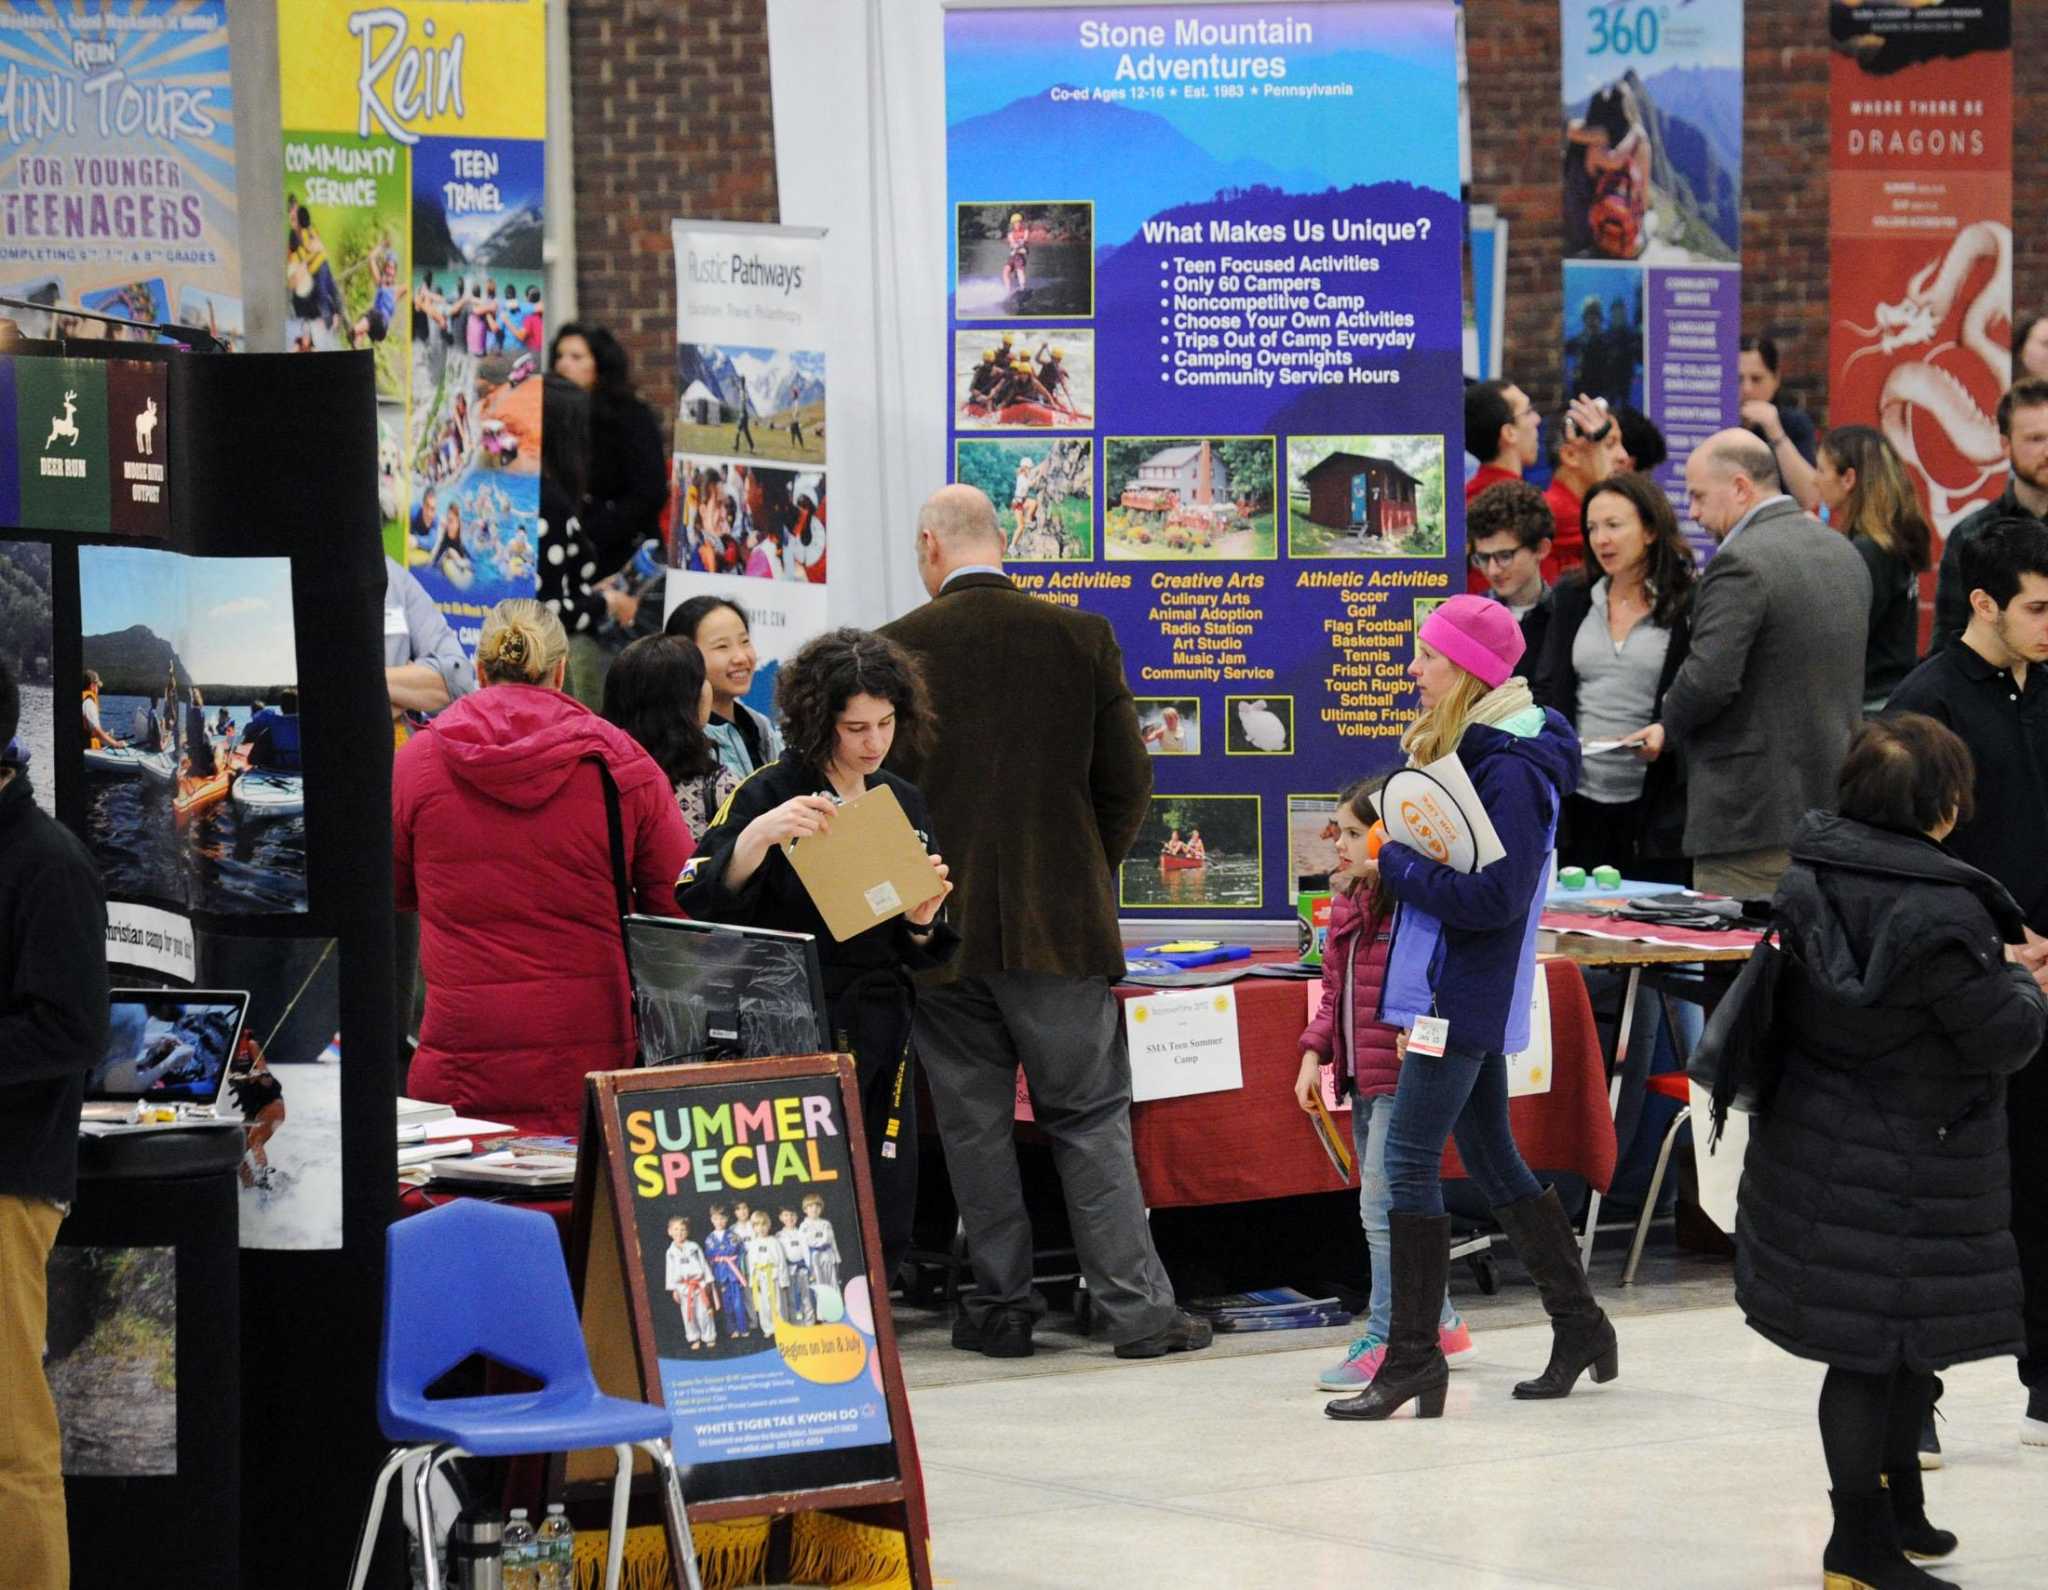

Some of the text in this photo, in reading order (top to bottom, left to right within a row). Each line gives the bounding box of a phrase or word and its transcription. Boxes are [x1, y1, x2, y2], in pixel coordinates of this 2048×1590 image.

[1079, 17, 1313, 48] Stone Mountain
[1114, 53, 1287, 81] Adventures
[349, 8, 465, 145] Rein
[1051, 83, 1353, 102] Co-ed Ages 12-16 Est. 1983 Pennsylvania
[1850, 100, 1984, 117] WHERE THERE BE
[1848, 129, 1984, 156] DRAGONS
[285, 143, 396, 176] COMMUNITY
[450, 149, 499, 179] TEEN
[19, 156, 180, 189] FOR YOUNGER
[305, 176, 377, 208] SERVICE
[443, 181, 504, 214] TRAVEL
[3, 193, 202, 242] TEENAGERS
[1142, 218, 1431, 246] What Makes Us Unique?
[0, 249, 76, 263] OMPLETING
[1174, 255, 1379, 273] Teen Focused Activities
[731, 254, 803, 297] Pathways
[1174, 275, 1321, 295] Only 60 Campers
[1174, 293, 1365, 315] Noncompetitive Camp
[1174, 310, 1414, 329] Choose Your Own Activities
[1174, 329, 1416, 350] Trips Out of Camp Everyday
[1174, 349, 1353, 369] Camping Overnights
[1174, 367, 1400, 388] Community Service Hours
[40, 457, 87, 478] DEER RUN
[1010, 571, 1132, 589] ture Activities
[1151, 572, 1265, 589] Creative Arts
[1296, 570, 1449, 587] Athletic Activities
[1028, 590, 1079, 607] limbing
[1161, 593, 1251, 607] Culinary Arts
[1340, 590, 1390, 603] Soccer
[1148, 607, 1263, 623] Animal Adoption
[1347, 605, 1377, 618] Golf
[1161, 622, 1253, 635] Radio Station
[1324, 619, 1412, 635] Flag Football
[1173, 637, 1242, 650] Art Studio
[1332, 634, 1404, 647] Basketball
[1173, 652, 1246, 664] Music Jam
[1343, 649, 1391, 662] Tennis
[1142, 667, 1275, 682] Community Service
[1332, 664, 1405, 677] Frisbi Golf
[1324, 679, 1416, 695] Touch Rugby
[1340, 693, 1393, 707] Softball
[1321, 708, 1378, 721] Ultimate
[1337, 723, 1404, 738] Volleyball
[1146, 1038, 1224, 1055] SMA Teen Summer
[1174, 1055, 1199, 1066] Camp
[626, 1095, 838, 1154] SUMMER
[633, 1140, 838, 1198] SPECIAL
[778, 1341, 808, 1361] Begins
[809, 1342, 820, 1357] on
[836, 1337, 844, 1353] &
[694, 1421, 736, 1437] WHITE
[737, 1418, 772, 1433] TIGER
[773, 1415, 795, 1429] TAE
[798, 1410, 838, 1426] KWON
[839, 1409, 858, 1421] DO
